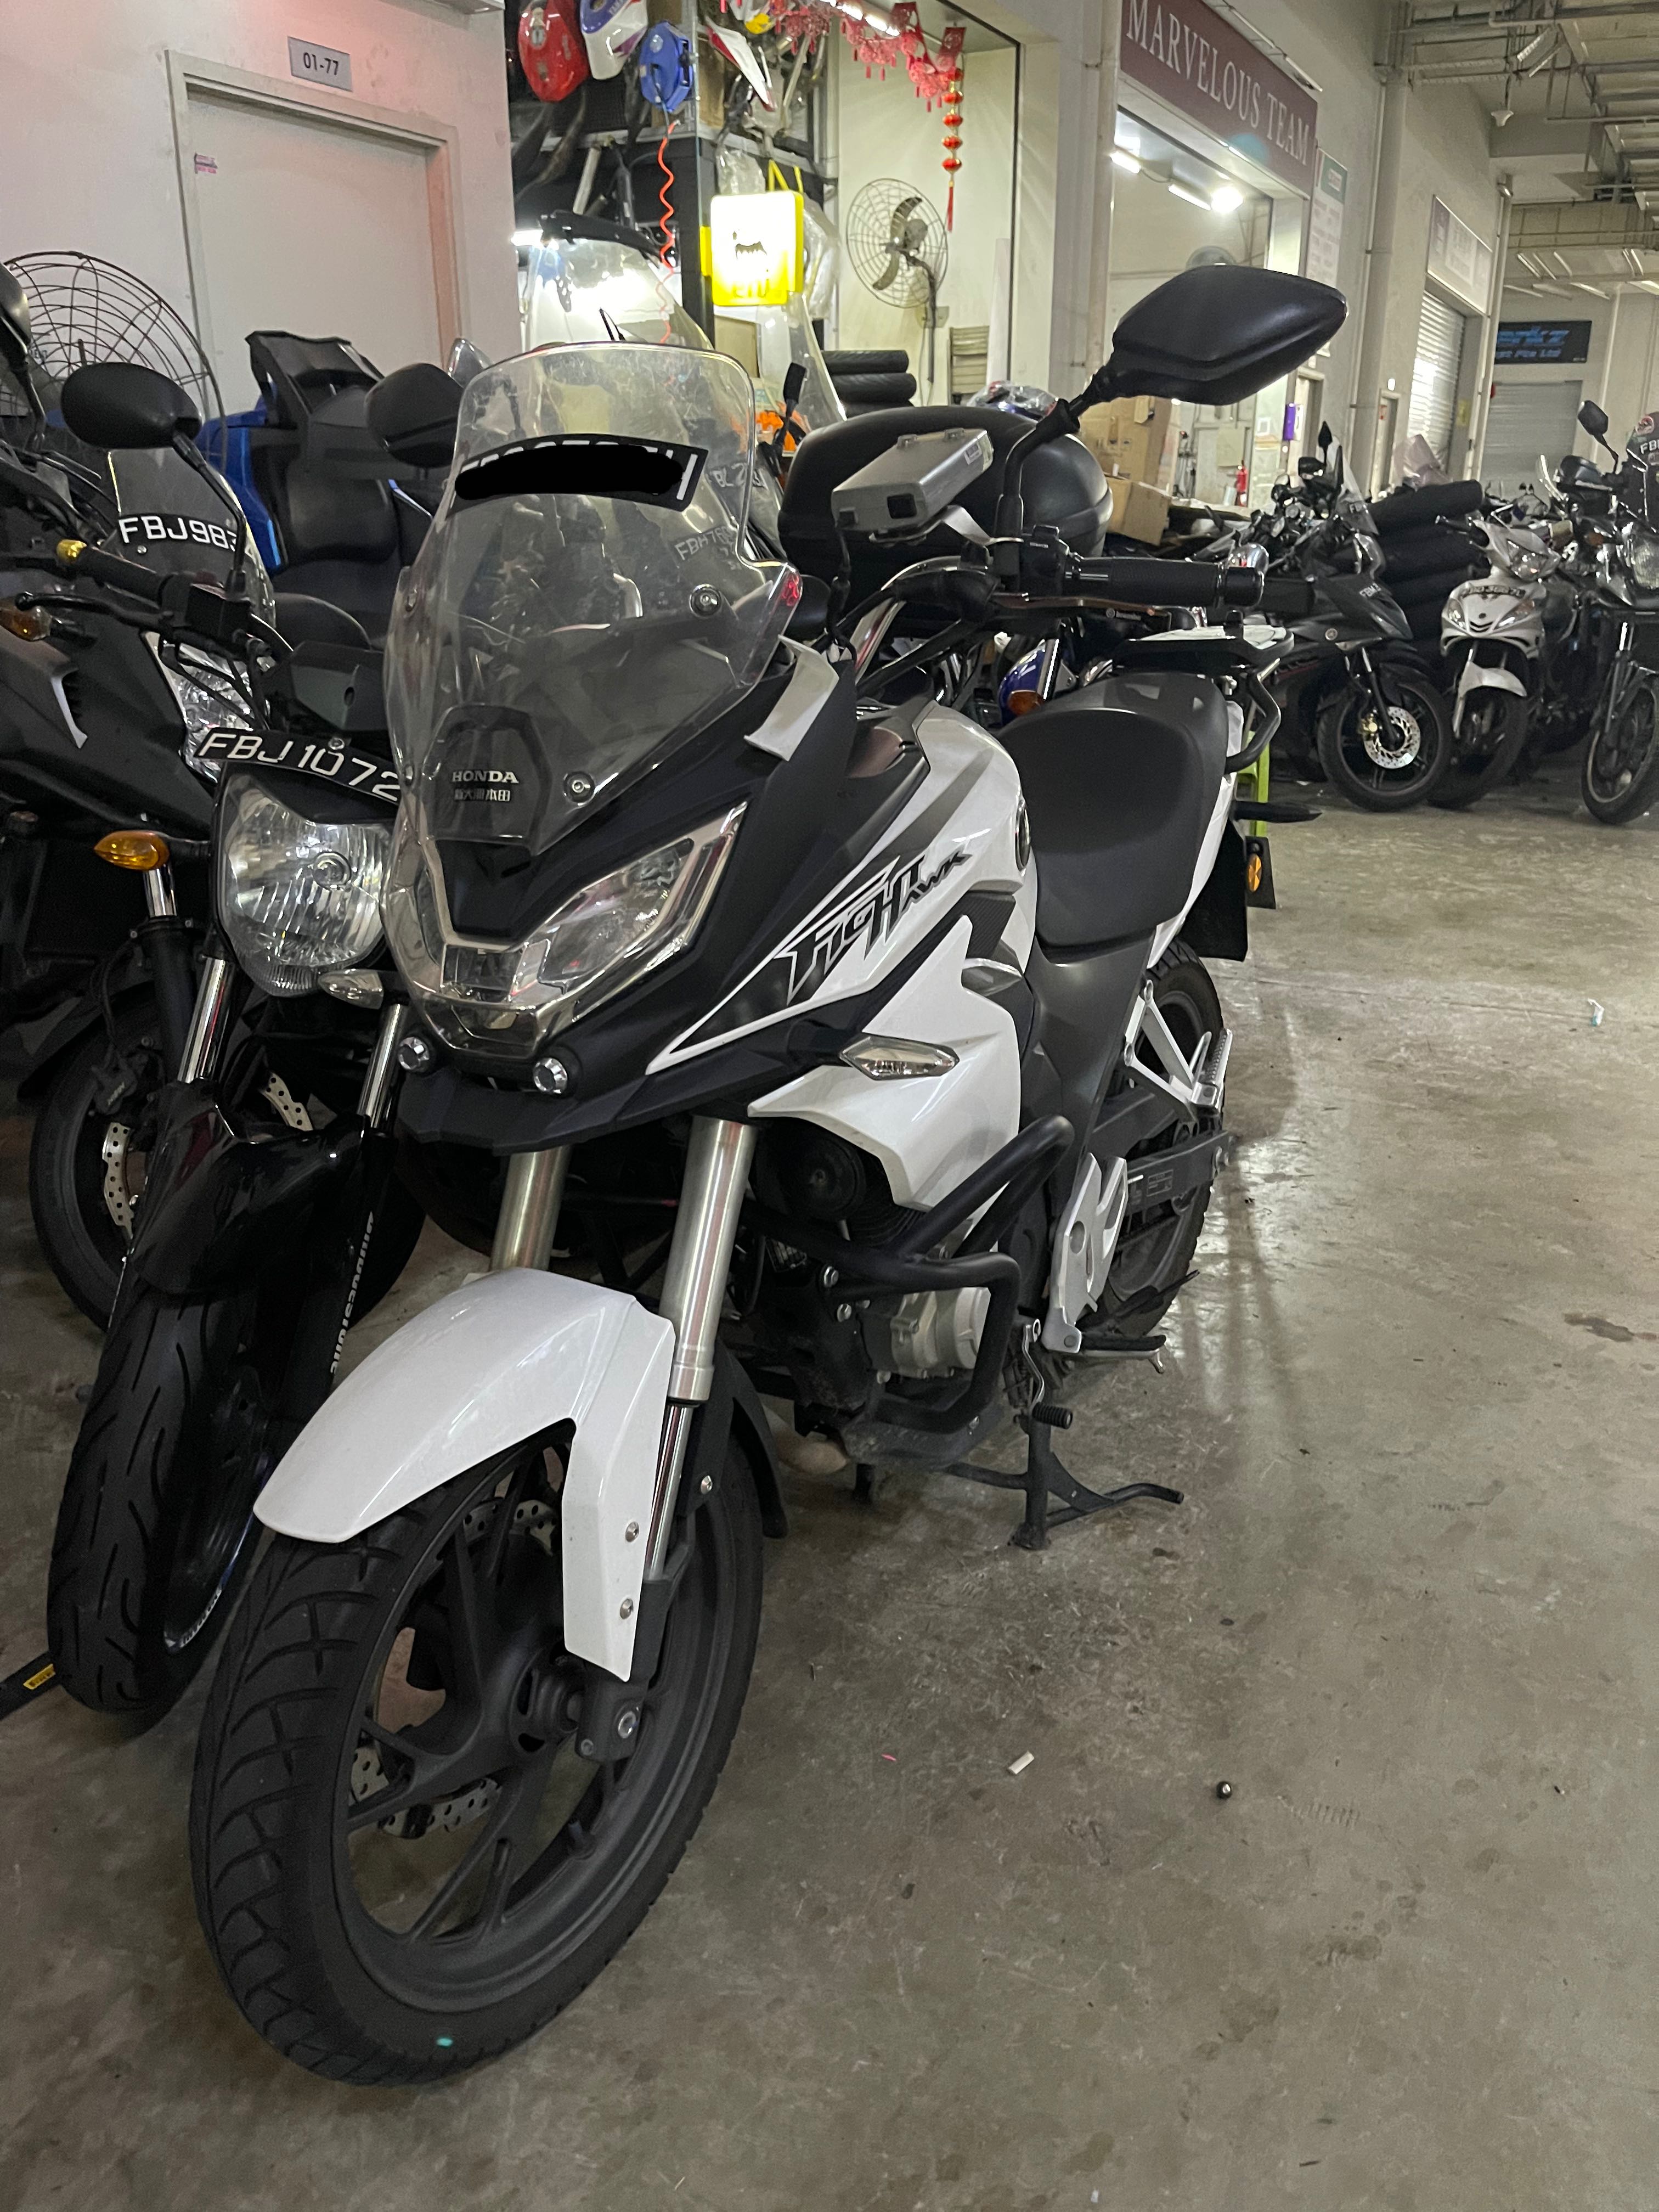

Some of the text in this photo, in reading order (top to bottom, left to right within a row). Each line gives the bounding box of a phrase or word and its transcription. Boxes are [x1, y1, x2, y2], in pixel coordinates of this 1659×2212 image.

[303, 52, 338, 75] 01-77
[1126, 0, 1310, 165] MARVELOUS TEAM
[452, 770, 520, 784] HONDA
